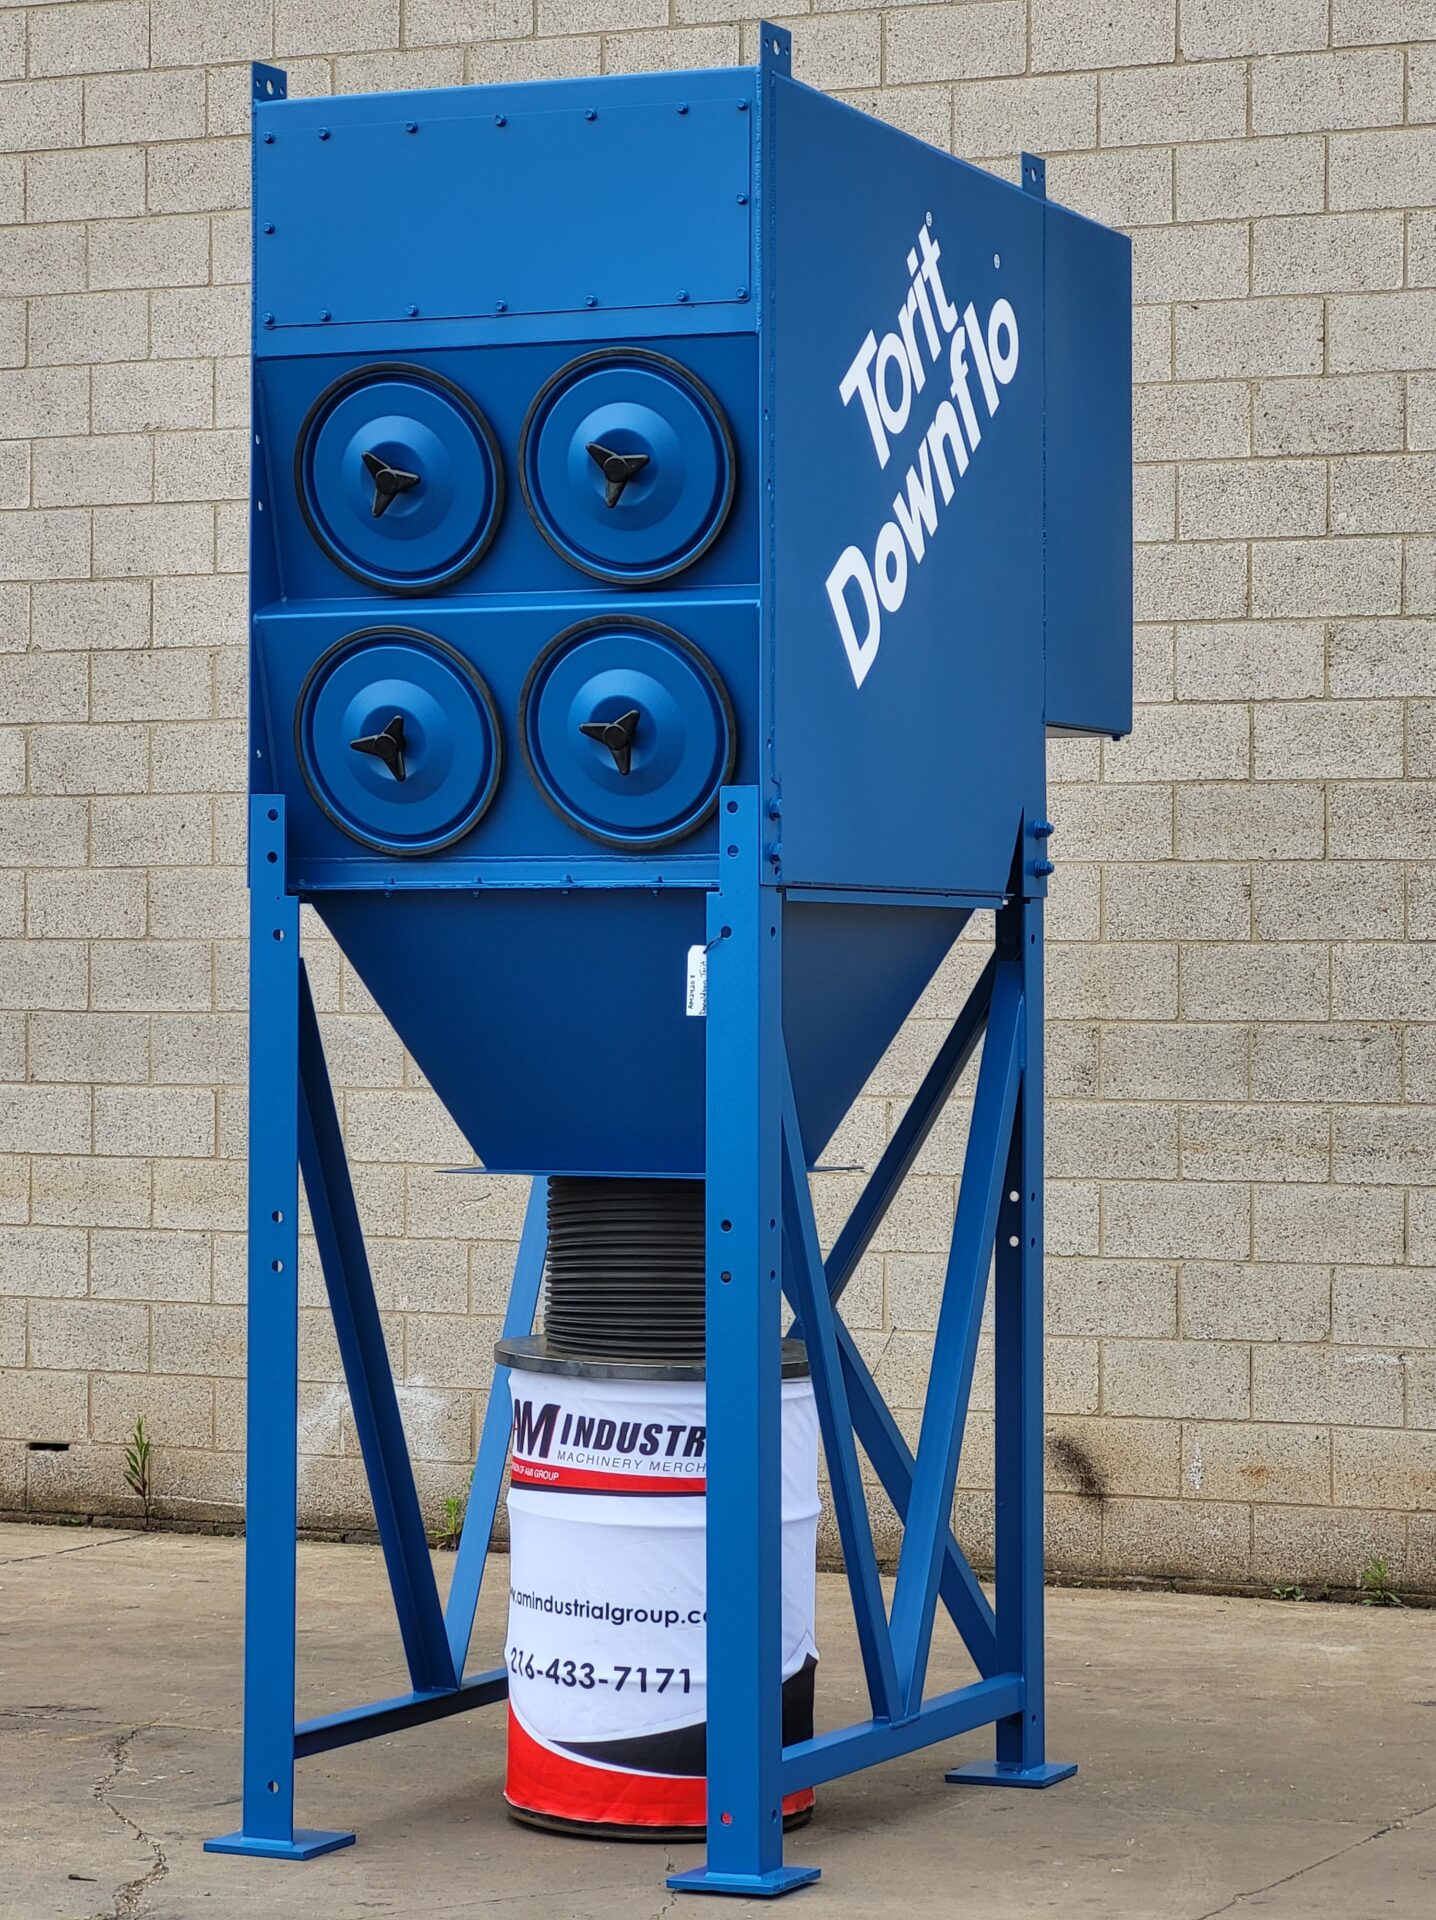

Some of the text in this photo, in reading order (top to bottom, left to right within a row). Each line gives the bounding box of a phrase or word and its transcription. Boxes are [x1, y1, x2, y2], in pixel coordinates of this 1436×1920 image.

[839, 224, 959, 470] Torit
[825, 298, 1019, 690] Downflo
[534, 1468, 560, 1481] GROUP
[557, 1450, 706, 1473] MACHINERY MERCH
[510, 1647, 690, 1693] 216-433-7171
